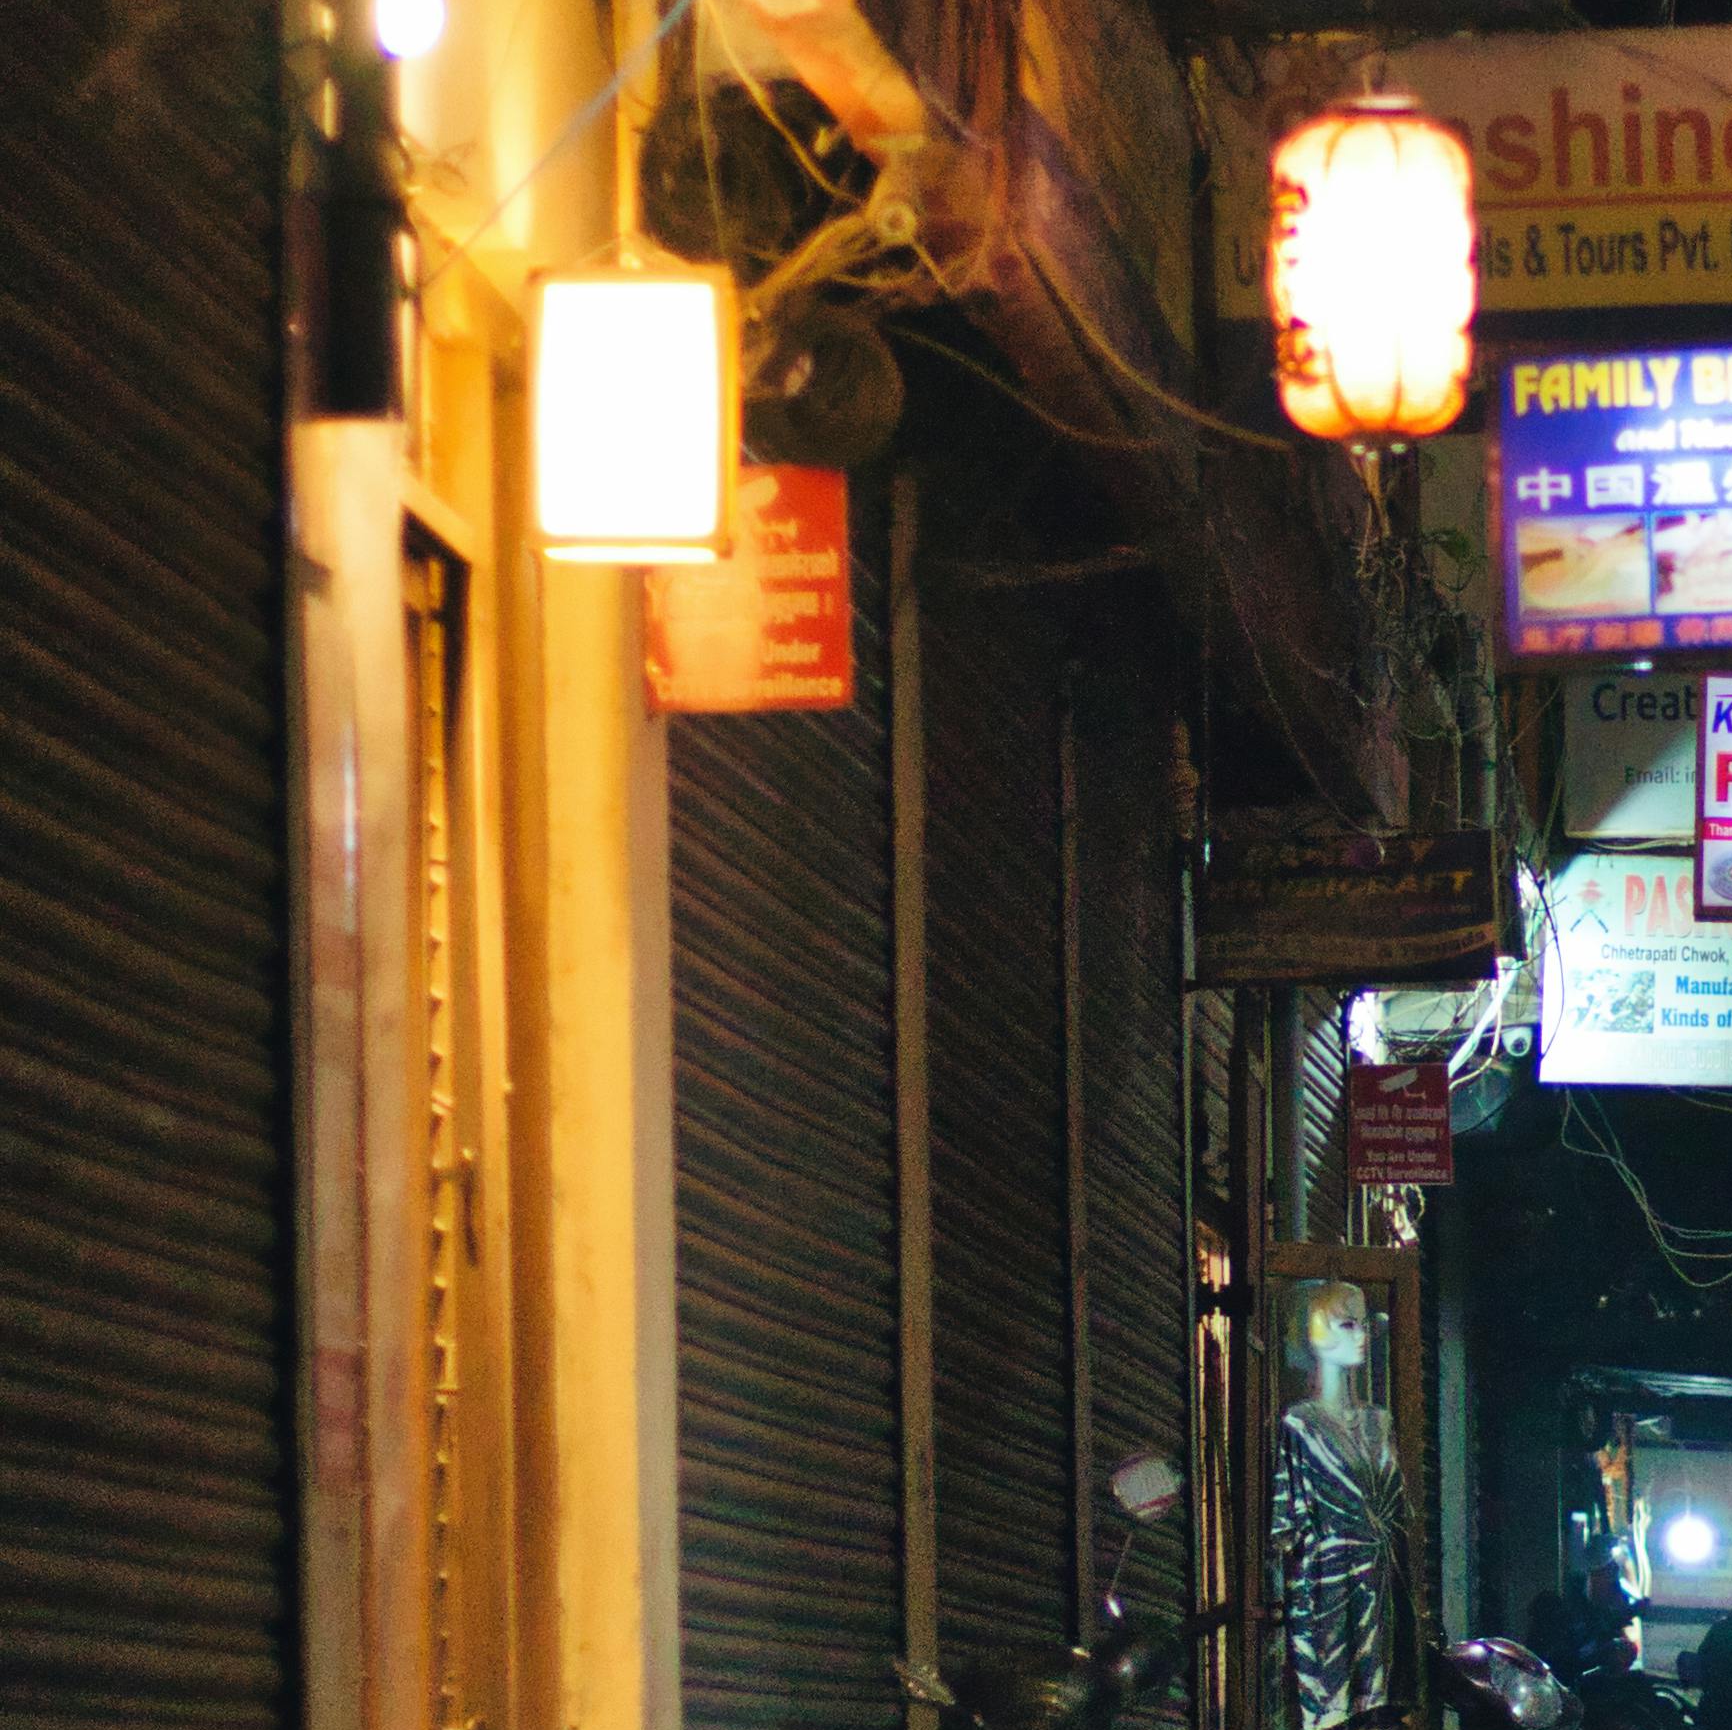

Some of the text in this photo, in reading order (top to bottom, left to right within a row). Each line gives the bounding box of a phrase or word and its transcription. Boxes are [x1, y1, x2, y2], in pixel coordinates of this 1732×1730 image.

[1522, 223, 1548, 278] &
[1557, 221, 1648, 274] Tours
[1658, 219, 1718, 270] Pvt.
[1514, 356, 1681, 417] FAMILY
[1592, 682, 1699, 722] Creat
[1624, 764, 1681, 785] Email:
[1600, 943, 1678, 965] Chhetrapati
[1681, 946, 1731, 967] Chwok,
[1660, 1007, 1711, 1030] Kinds
[1355, 1165, 1385, 1181] CCTV
